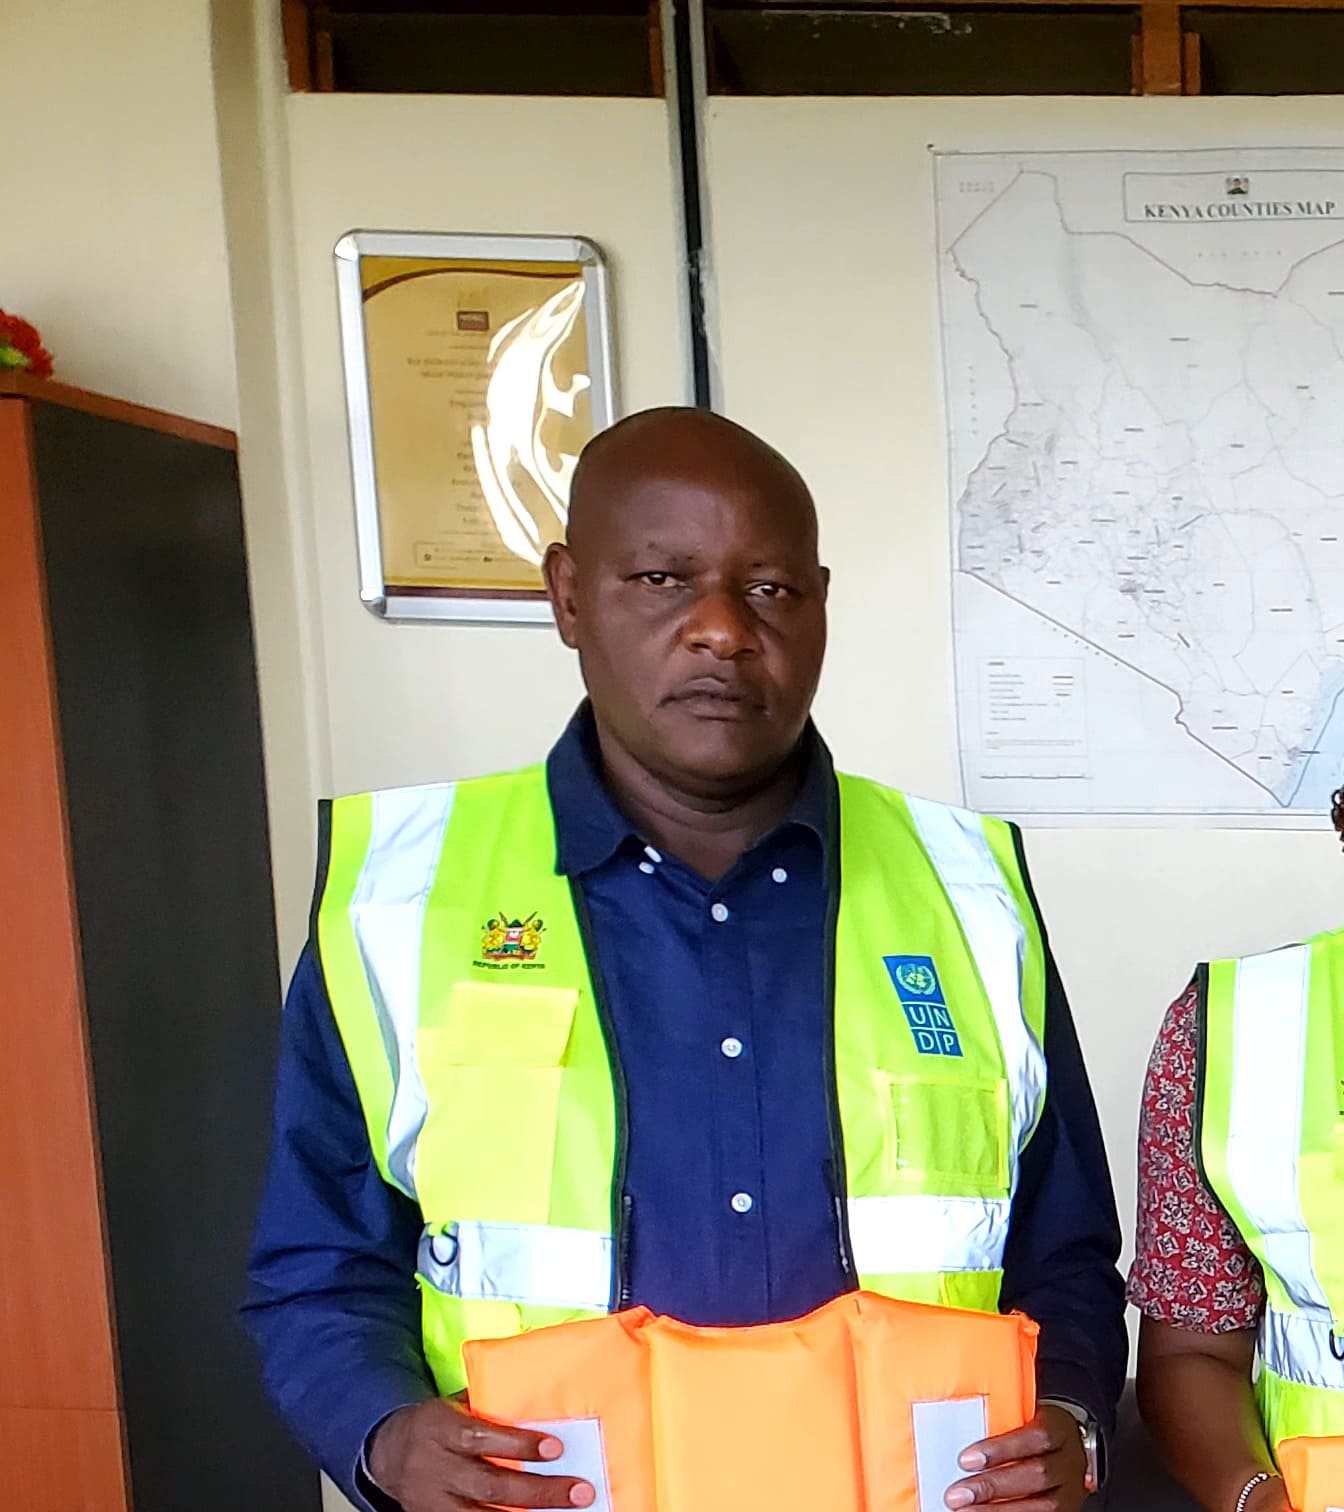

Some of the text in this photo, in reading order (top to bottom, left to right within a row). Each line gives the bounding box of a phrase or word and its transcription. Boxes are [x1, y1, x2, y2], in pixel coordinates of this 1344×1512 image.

[1144, 201, 1336, 218] KENYA COUNTIES MAP
